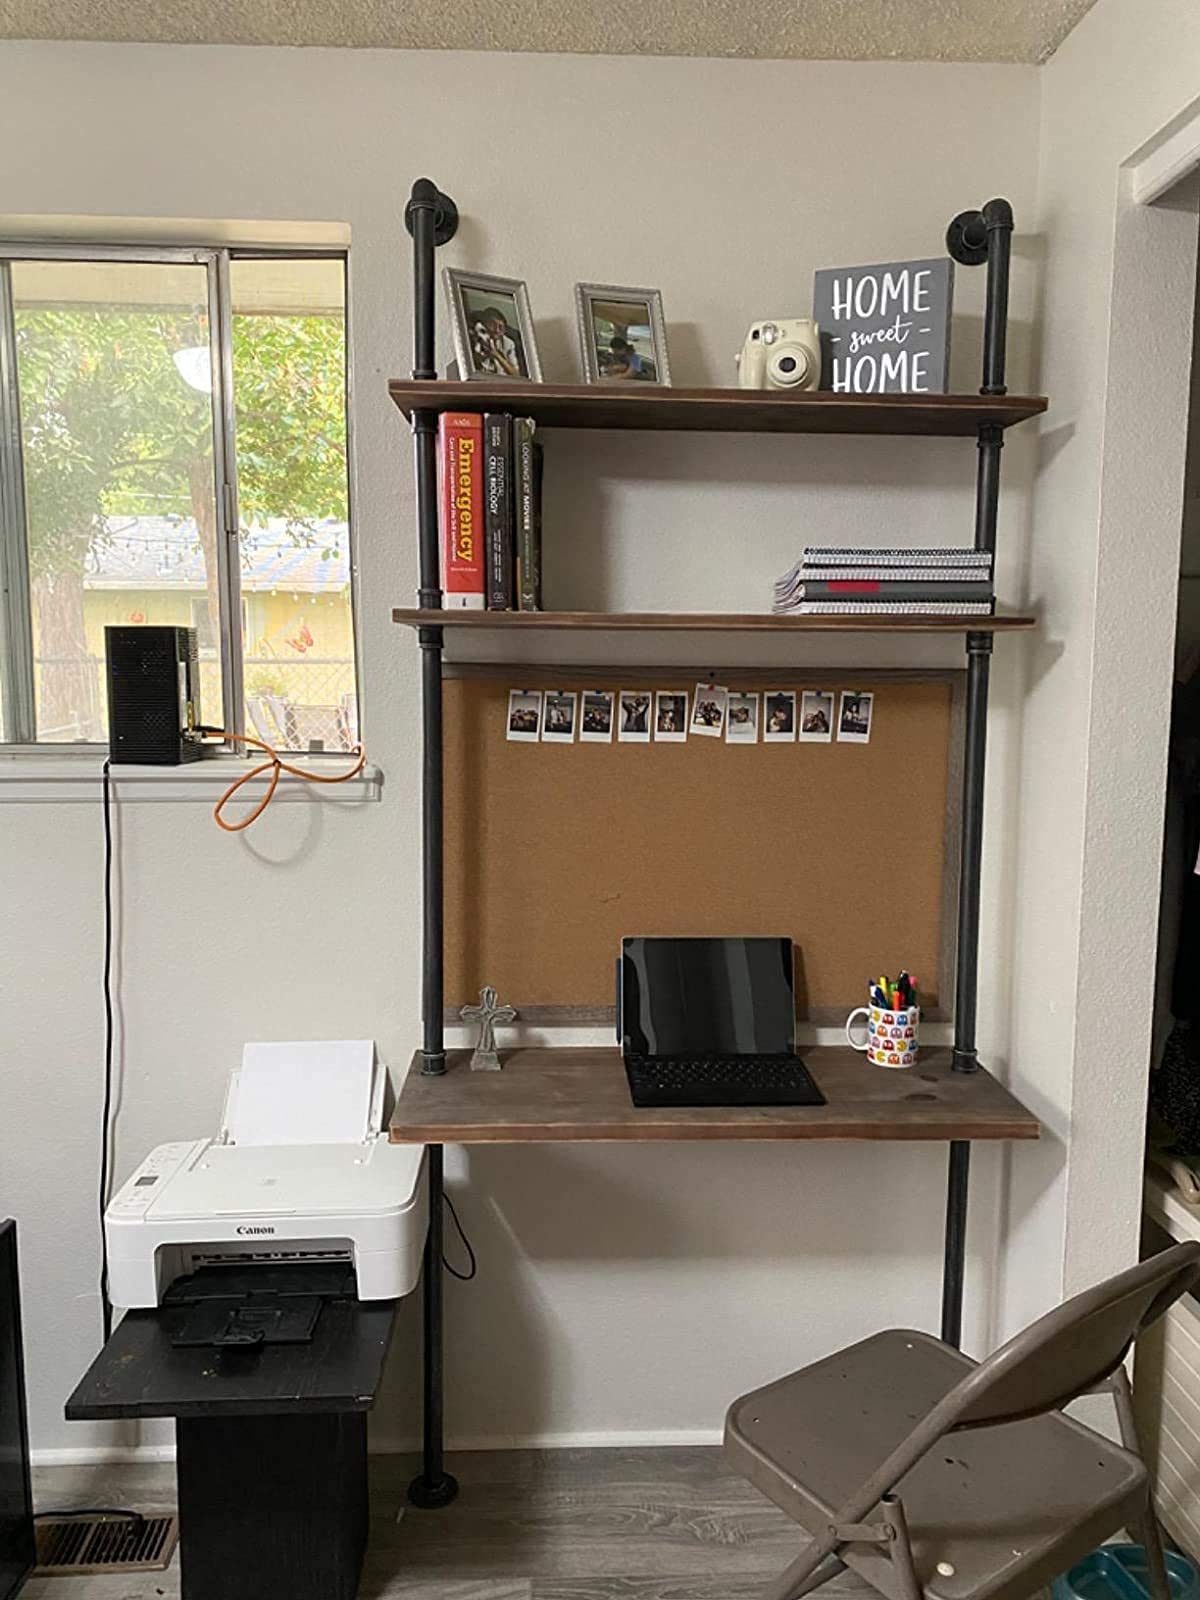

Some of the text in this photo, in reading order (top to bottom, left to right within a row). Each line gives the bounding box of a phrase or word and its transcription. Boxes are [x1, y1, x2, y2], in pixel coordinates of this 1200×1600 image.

[832, 269, 932, 321] HOME
[849, 314, 913, 353] sweet
[832, 350, 930, 393] HOME
[488, 455, 497, 475] CELL
[522, 442, 530, 481] LOOKING
[455, 437, 474, 562] Emergency
[490, 477, 498, 514] BIOLOGY
[523, 482, 530, 494] AT
[236, 1226, 275, 1235] Canon
